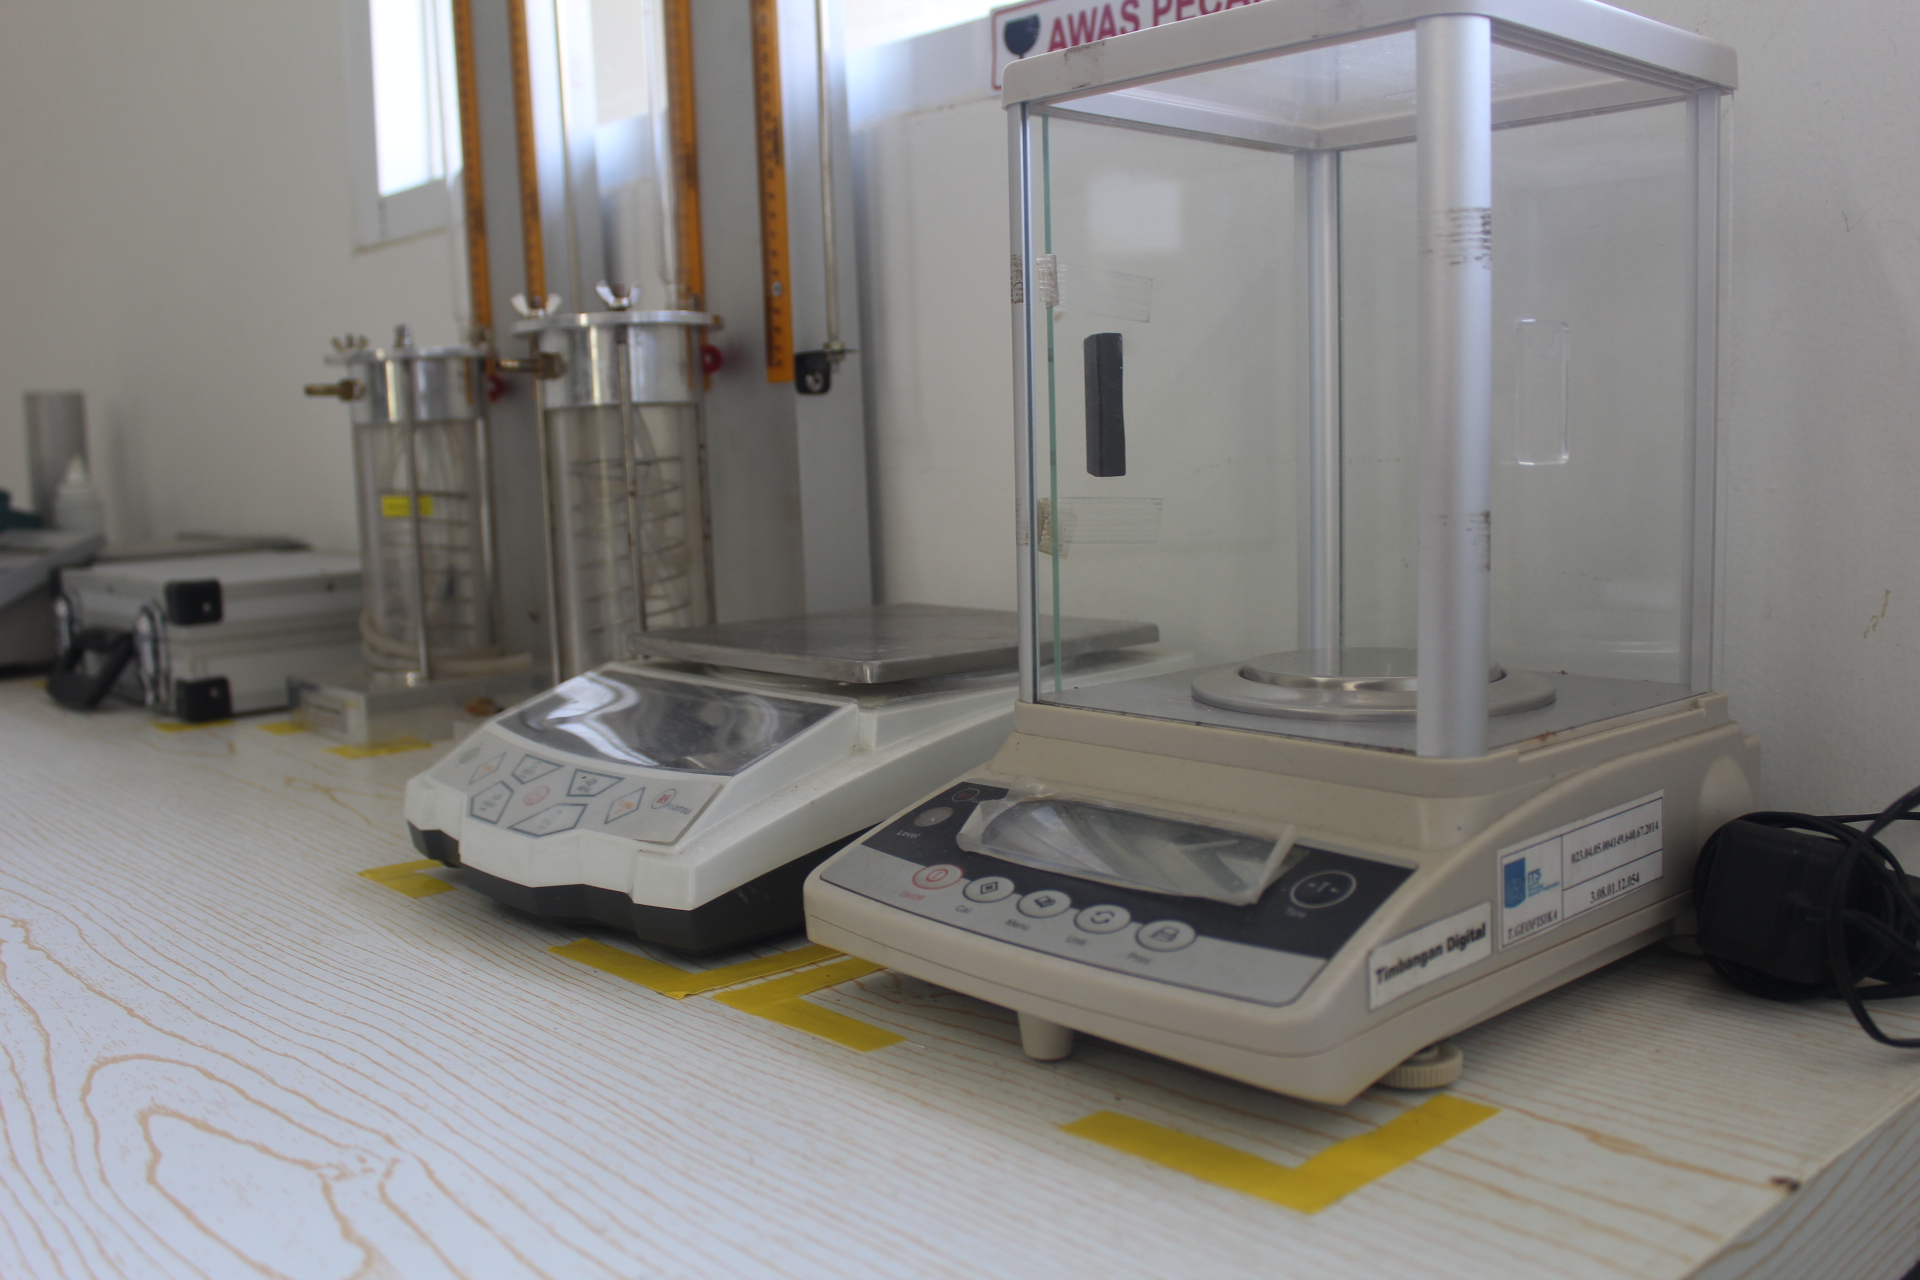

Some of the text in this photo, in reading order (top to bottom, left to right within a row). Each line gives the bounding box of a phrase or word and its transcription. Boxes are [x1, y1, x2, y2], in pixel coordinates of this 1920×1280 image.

[1047, 0, 1259, 52] AWAS PE
[896, 830, 922, 839] Level
[1375, 921, 1487, 985] Timbangan Digital
